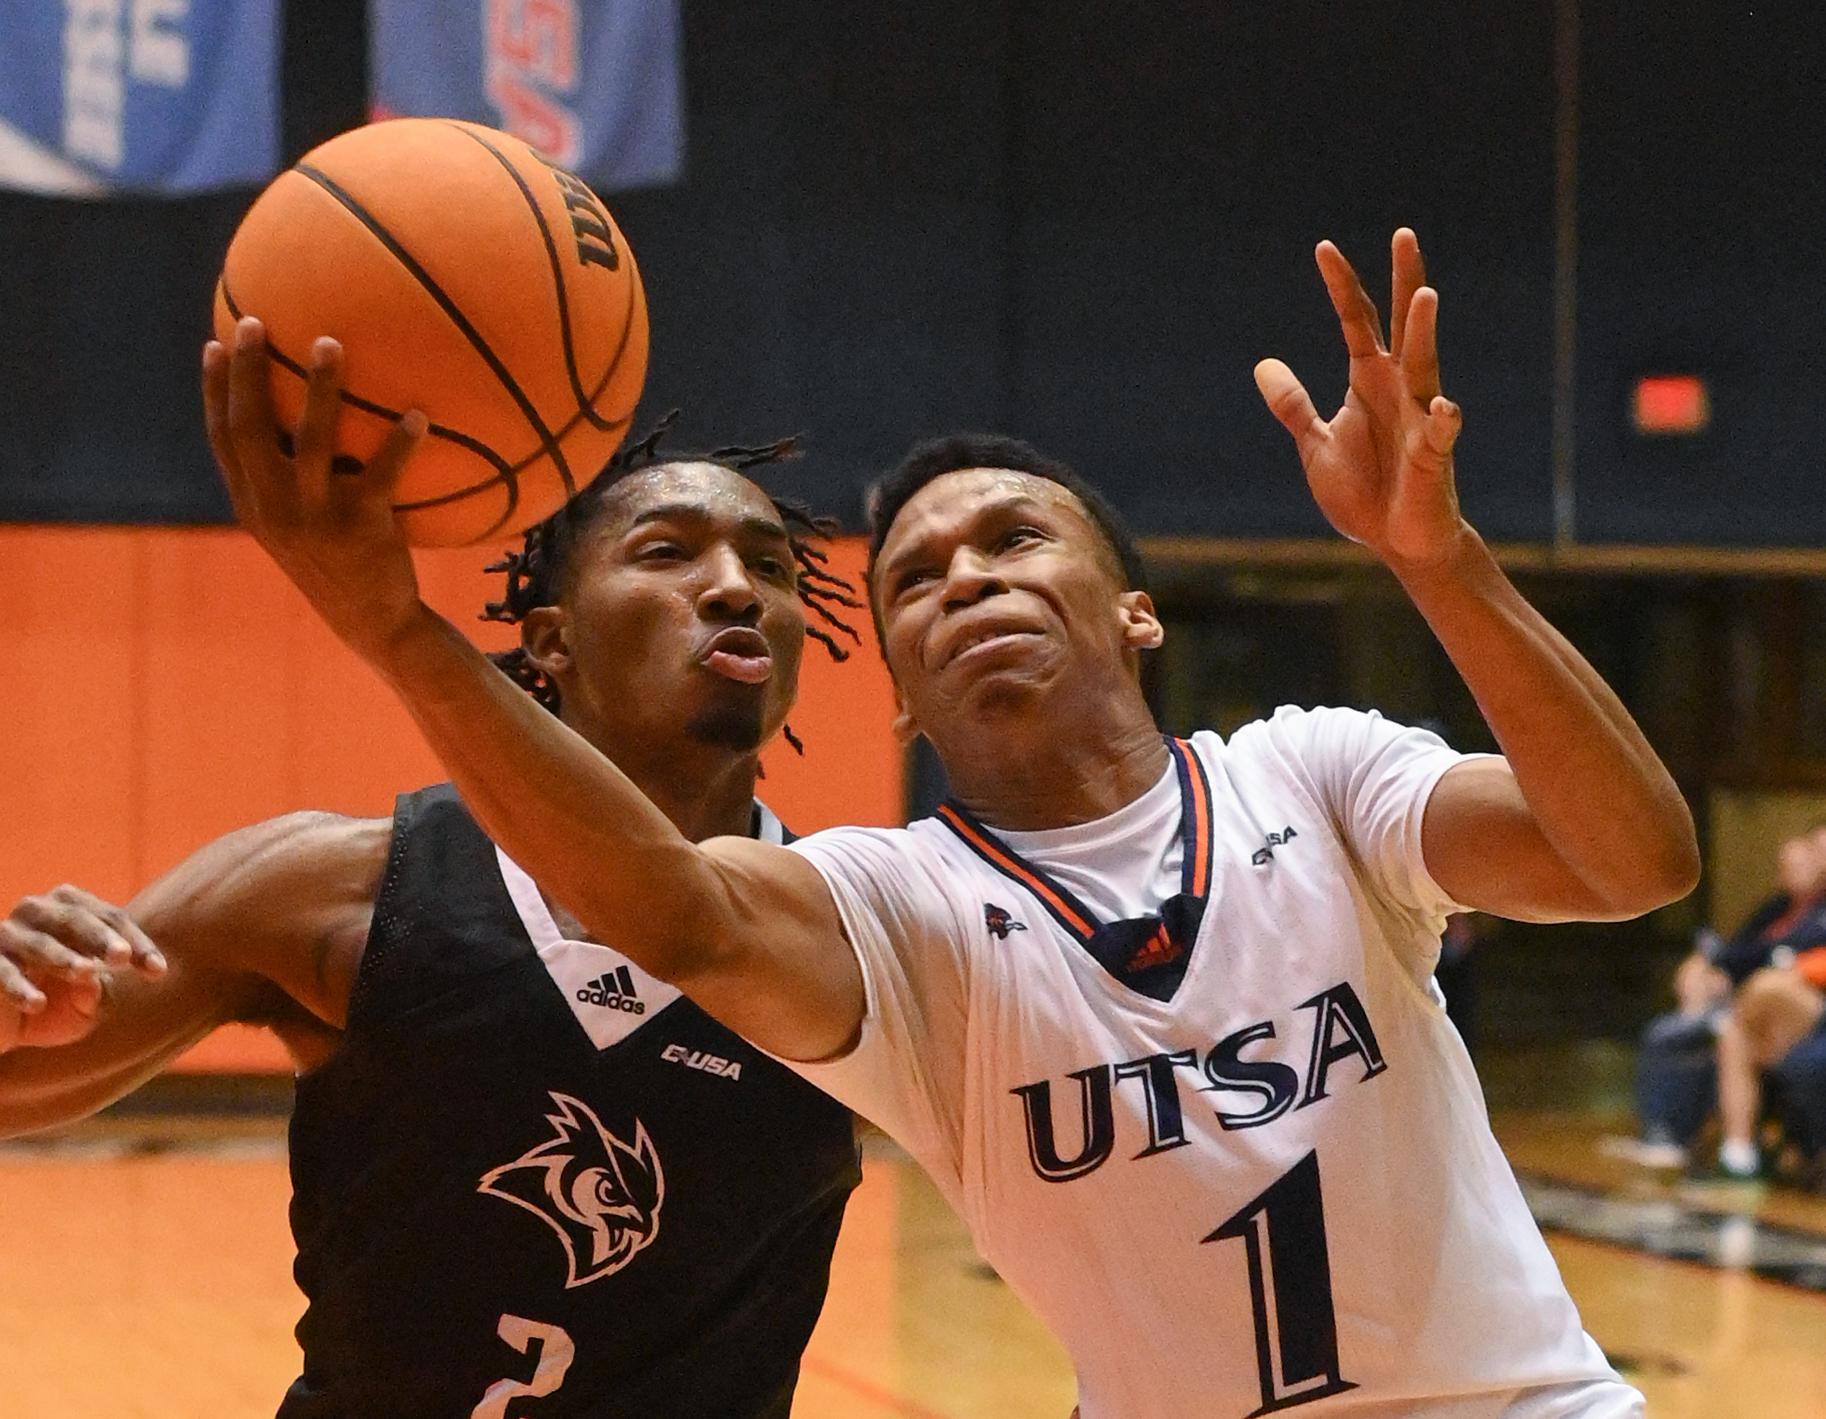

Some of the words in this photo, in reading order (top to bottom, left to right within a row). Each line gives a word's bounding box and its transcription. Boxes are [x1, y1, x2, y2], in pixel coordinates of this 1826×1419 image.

[576, 987, 646, 1015] adidas
[1010, 981, 1388, 1183] UTSA
[1200, 1148, 1361, 1419] 1
[469, 1313, 576, 1419] 2
